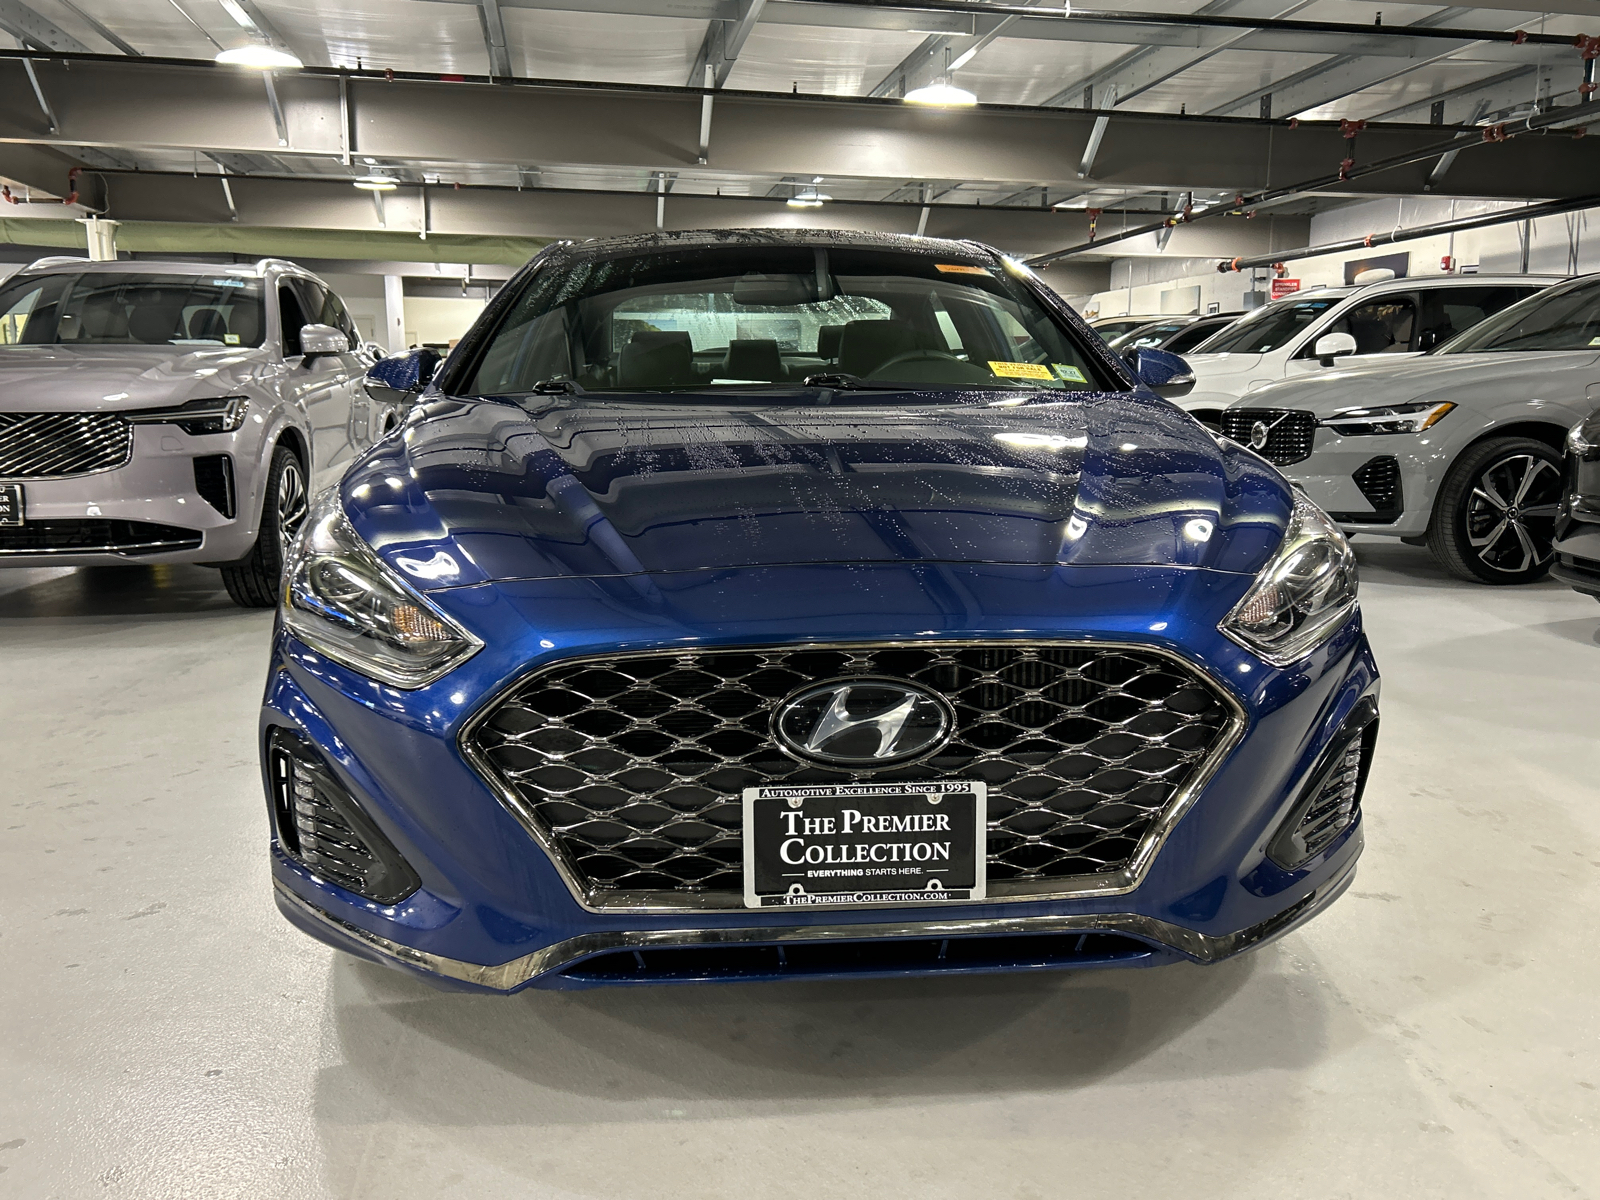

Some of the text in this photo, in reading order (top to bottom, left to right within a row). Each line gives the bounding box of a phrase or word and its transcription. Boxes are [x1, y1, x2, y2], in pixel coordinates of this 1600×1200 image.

[761, 783, 970, 798] AUTOMOTIVE EXCELLENCE SINCE 1995
[780, 809, 952, 836] THE PREMIER
[780, 838, 952, 865] COLLECTION
[807, 867, 924, 878] EVERYTHING STARTS HERE.
